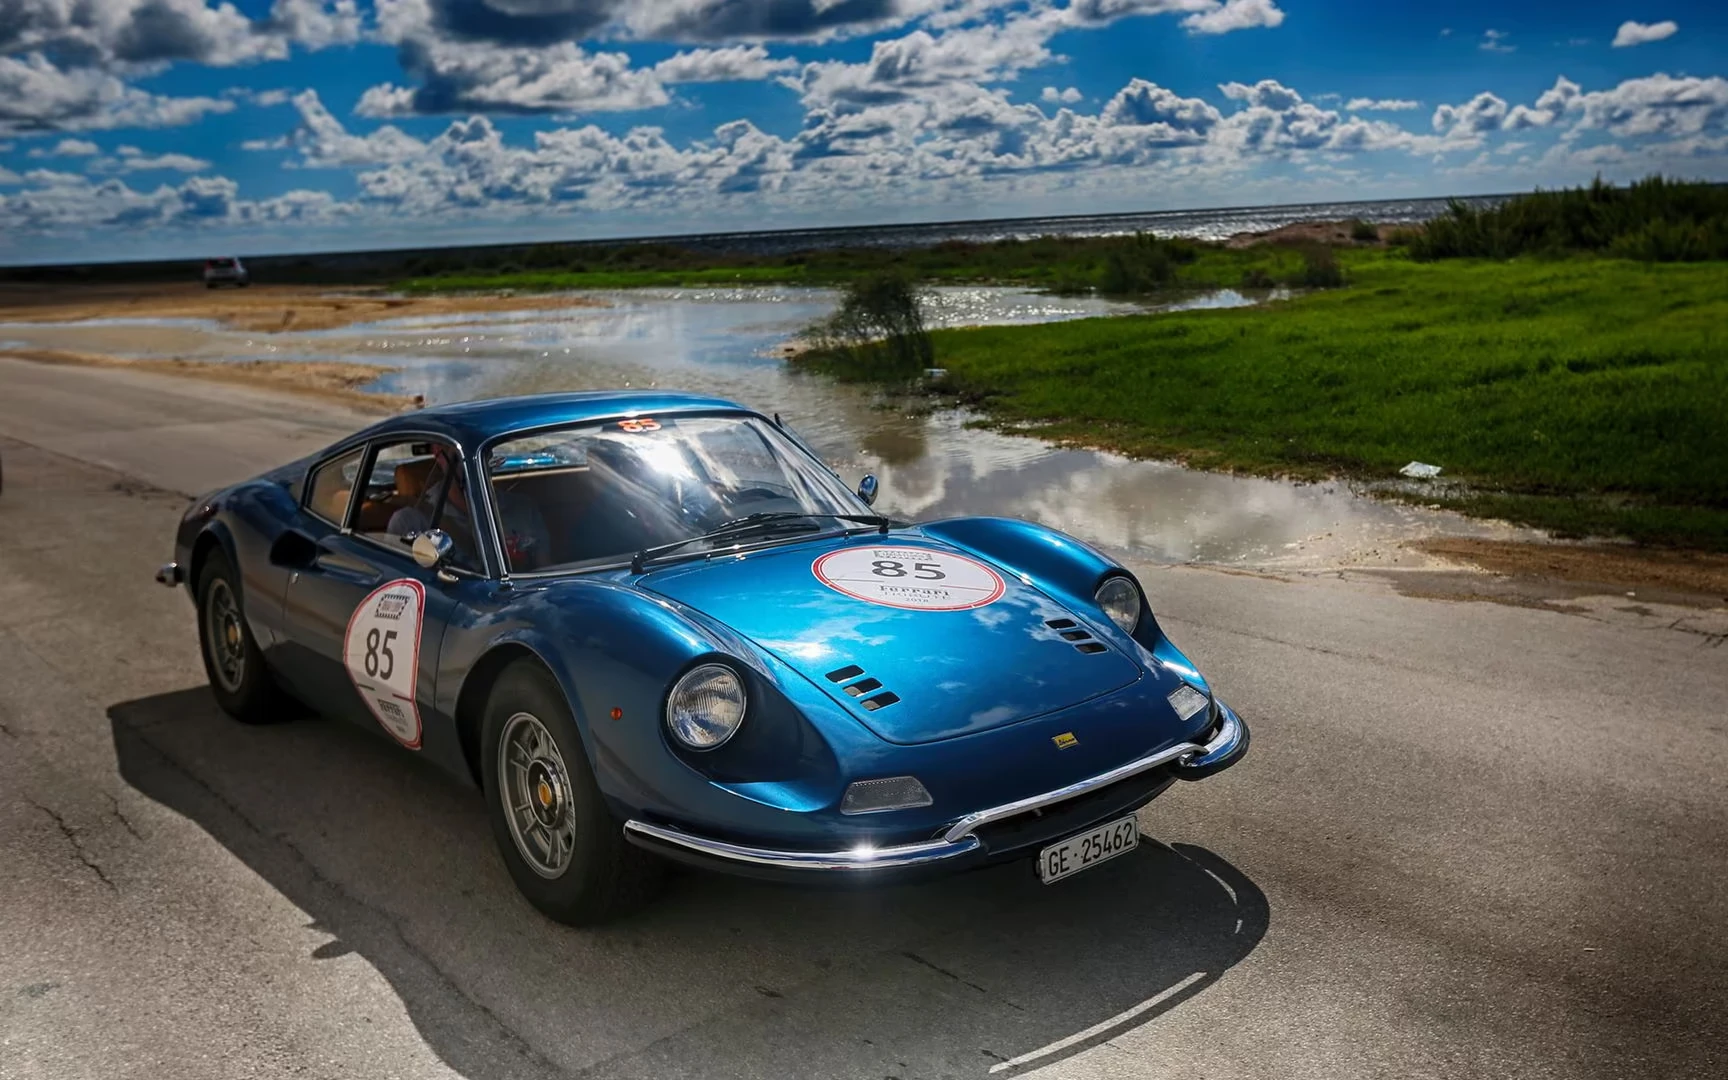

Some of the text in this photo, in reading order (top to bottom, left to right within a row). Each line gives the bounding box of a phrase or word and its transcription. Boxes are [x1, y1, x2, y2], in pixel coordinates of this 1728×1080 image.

[617, 418, 661, 432] 85
[872, 560, 946, 580] 85
[880, 585, 949, 597] Ferrari
[365, 628, 397, 680] 85
